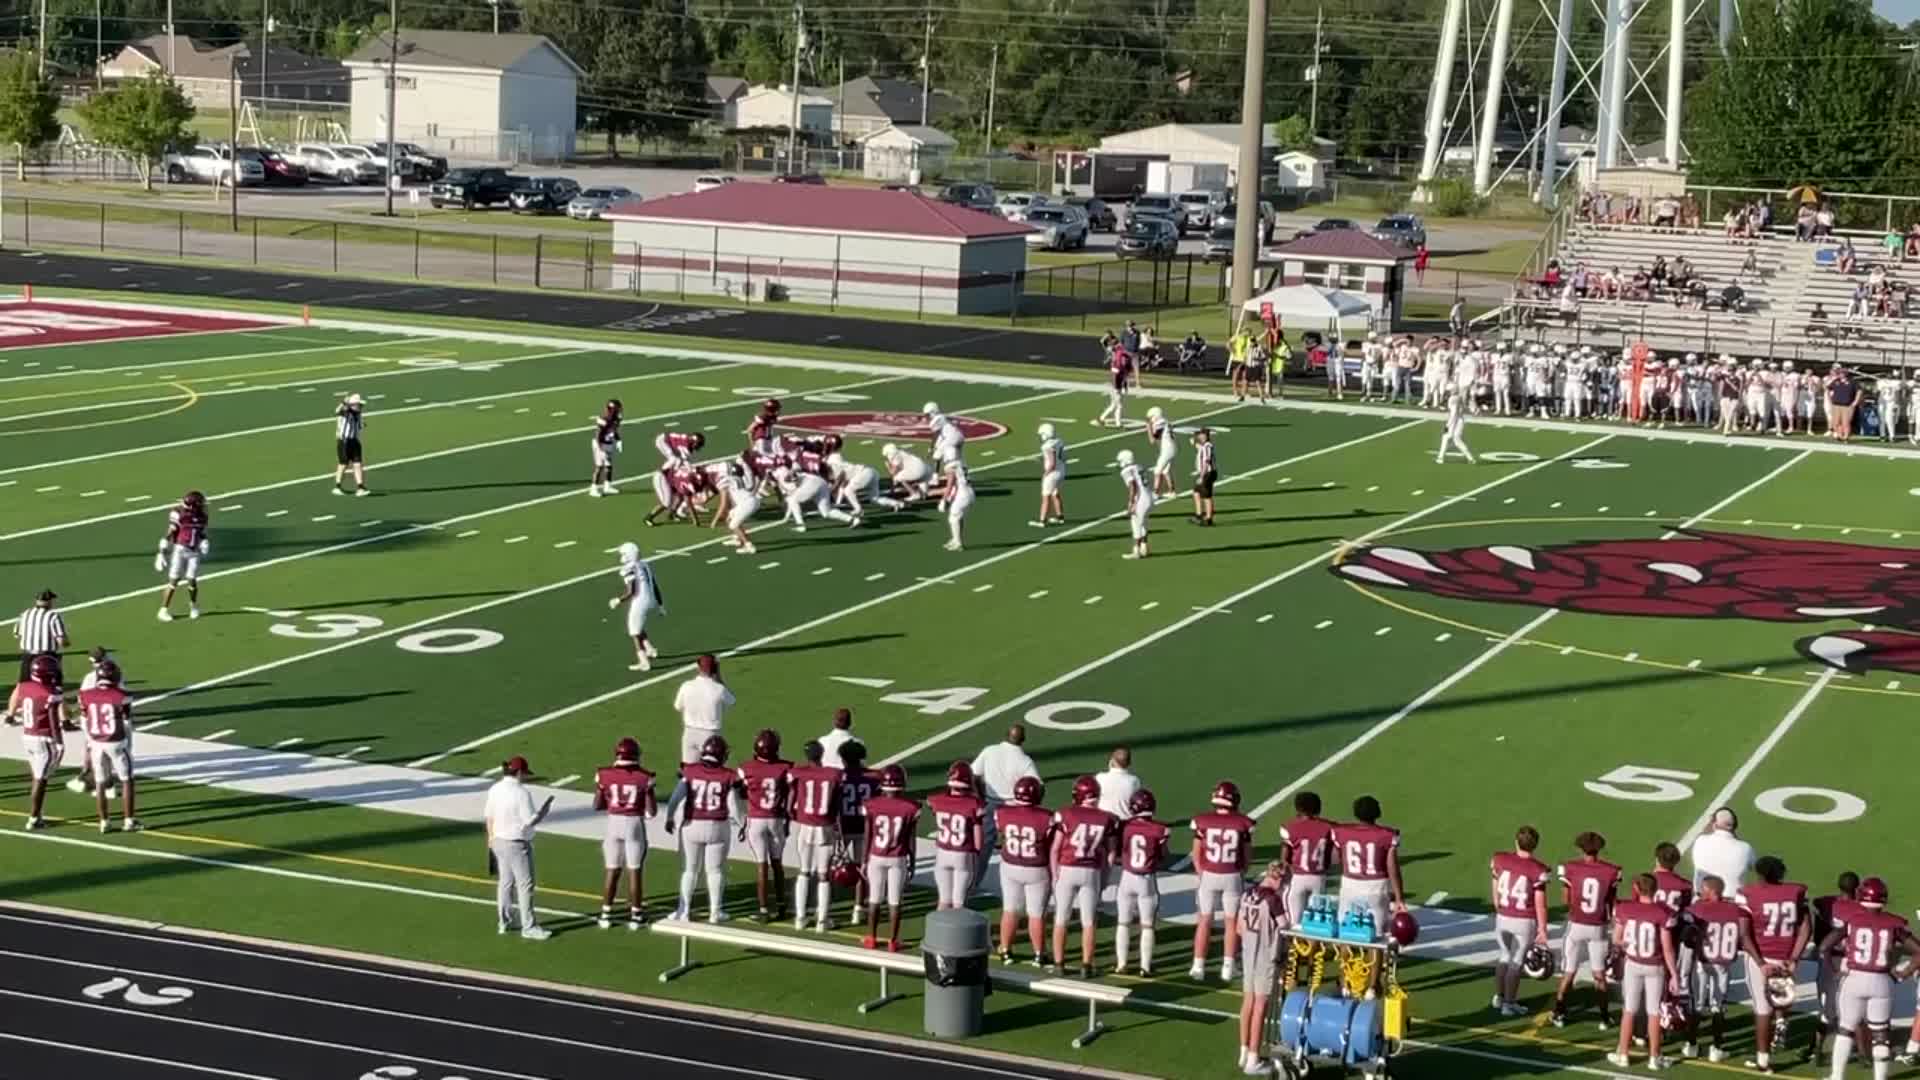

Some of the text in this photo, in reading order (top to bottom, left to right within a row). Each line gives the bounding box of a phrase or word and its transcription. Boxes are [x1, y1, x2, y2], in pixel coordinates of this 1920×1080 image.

[23, 697, 34, 729] 8
[88, 703, 116, 735] 13
[610, 783, 637, 809] 17
[692, 780, 721, 810] 76
[760, 778, 776, 808] 3
[804, 780, 830, 815] 11
[874, 815, 903, 848] 31
[936, 812, 966, 847] 59
[1005, 824, 1037, 857] 62
[1070, 823, 1105, 858] 47
[1206, 828, 1239, 863] 52
[1130, 834, 1146, 868] 6
[1299, 838, 1327, 872] 14
[1345, 841, 1376, 874] 61
[1497, 870, 1528, 910] 44
[1581, 877, 1600, 913] 9
[1763, 902, 1797, 937] 72
[1623, 919, 1656, 958] 40
[1703, 922, 1738, 960] 38
[1854, 928, 1889, 966] 91
